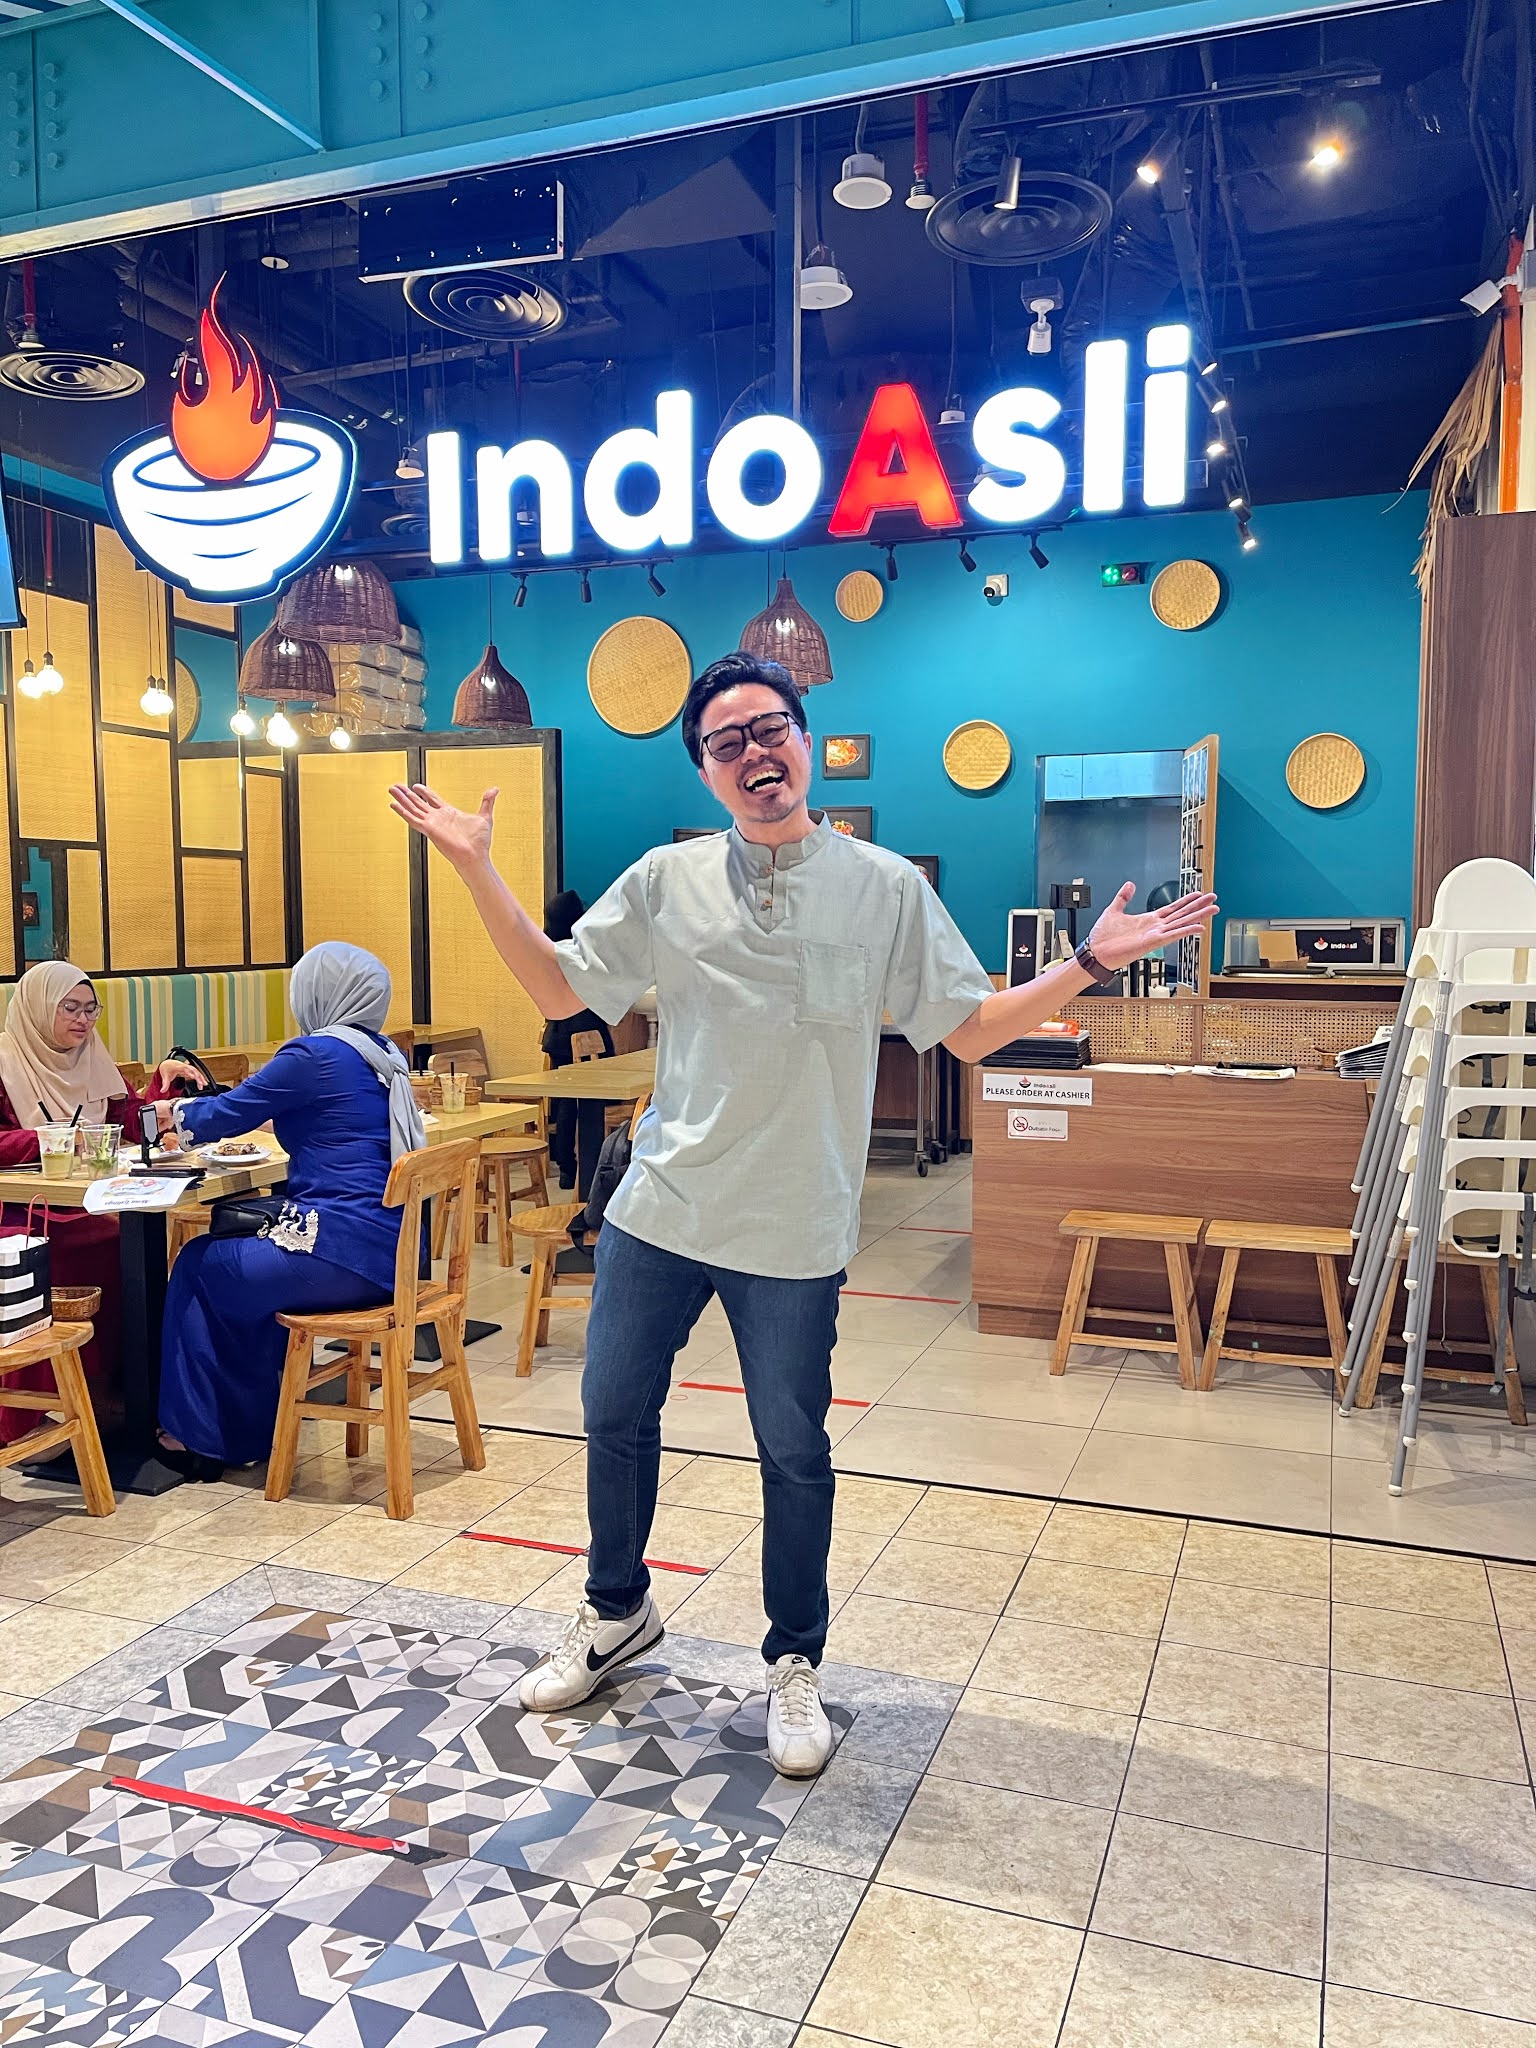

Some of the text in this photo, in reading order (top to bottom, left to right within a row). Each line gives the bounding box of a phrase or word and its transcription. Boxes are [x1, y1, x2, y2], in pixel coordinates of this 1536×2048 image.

[427, 325, 1190, 565] IndoAsli
[986, 1087, 1090, 1100] PLEASE ORDER AT CASHIER
